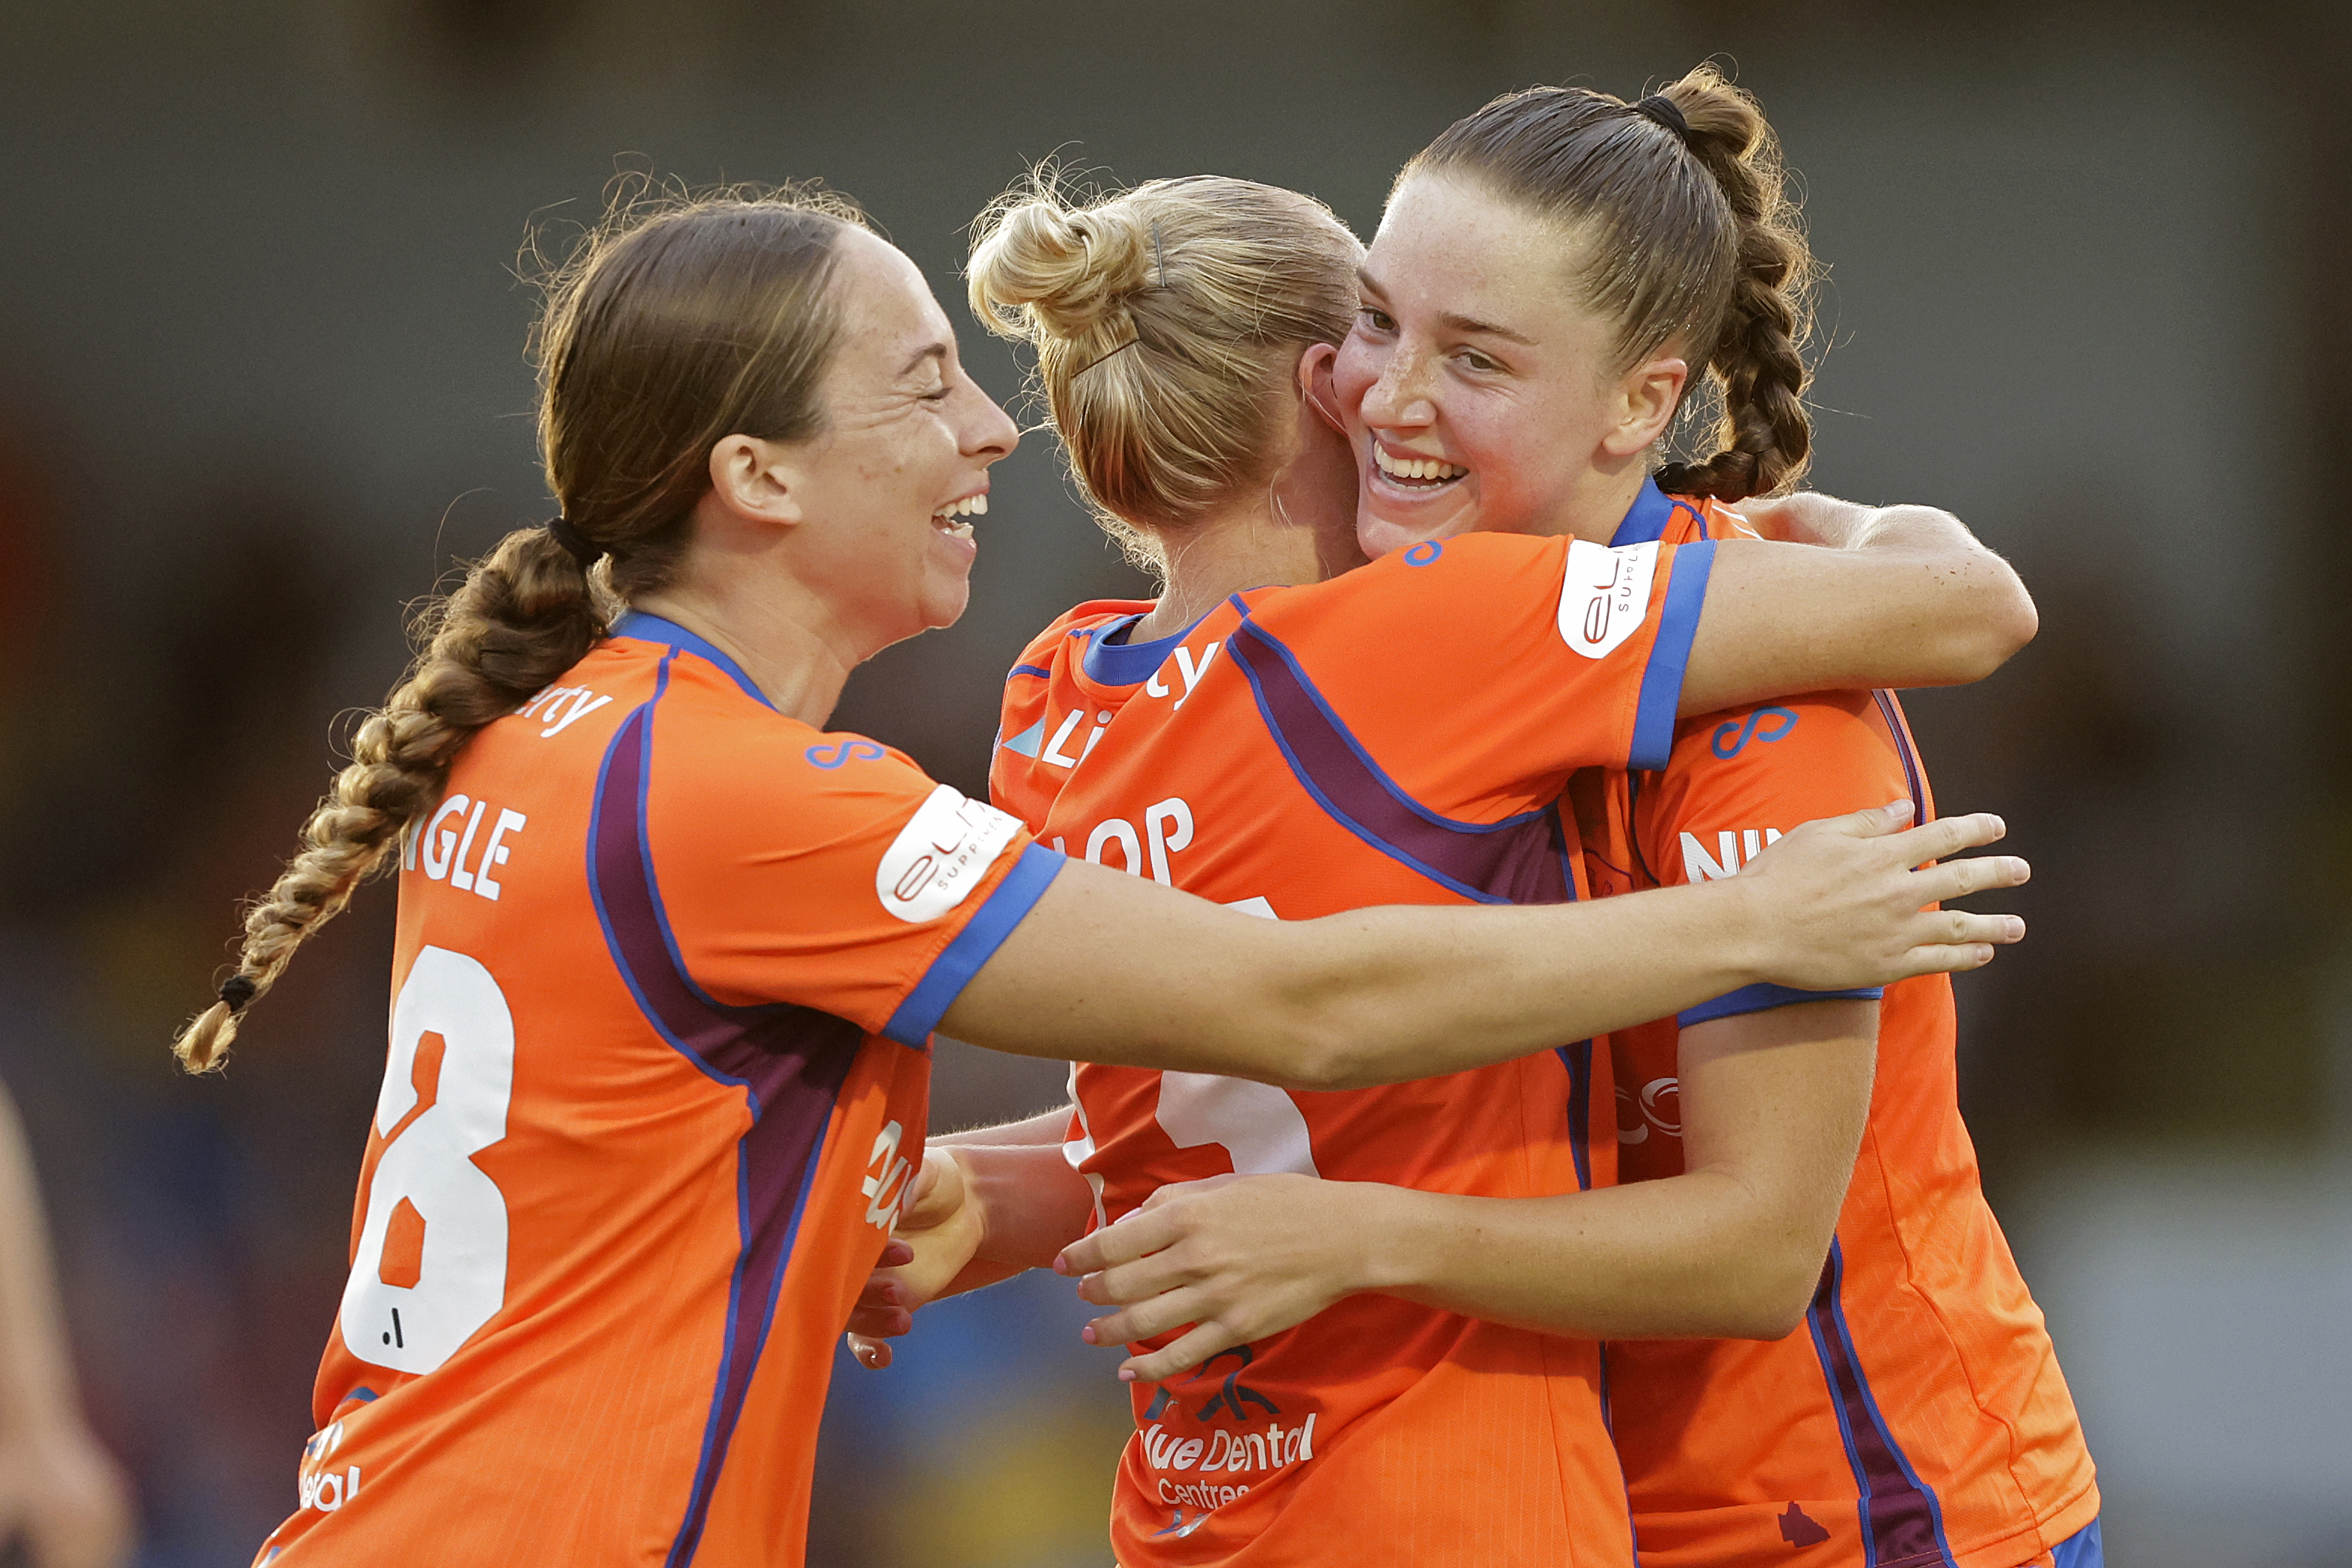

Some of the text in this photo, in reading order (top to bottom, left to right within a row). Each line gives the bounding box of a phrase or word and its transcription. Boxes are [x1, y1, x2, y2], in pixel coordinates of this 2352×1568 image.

[1052, 796, 1195, 888] OP
[341, 944, 515, 1376] 8
[1139, 1412, 1317, 1472] lue Dental
